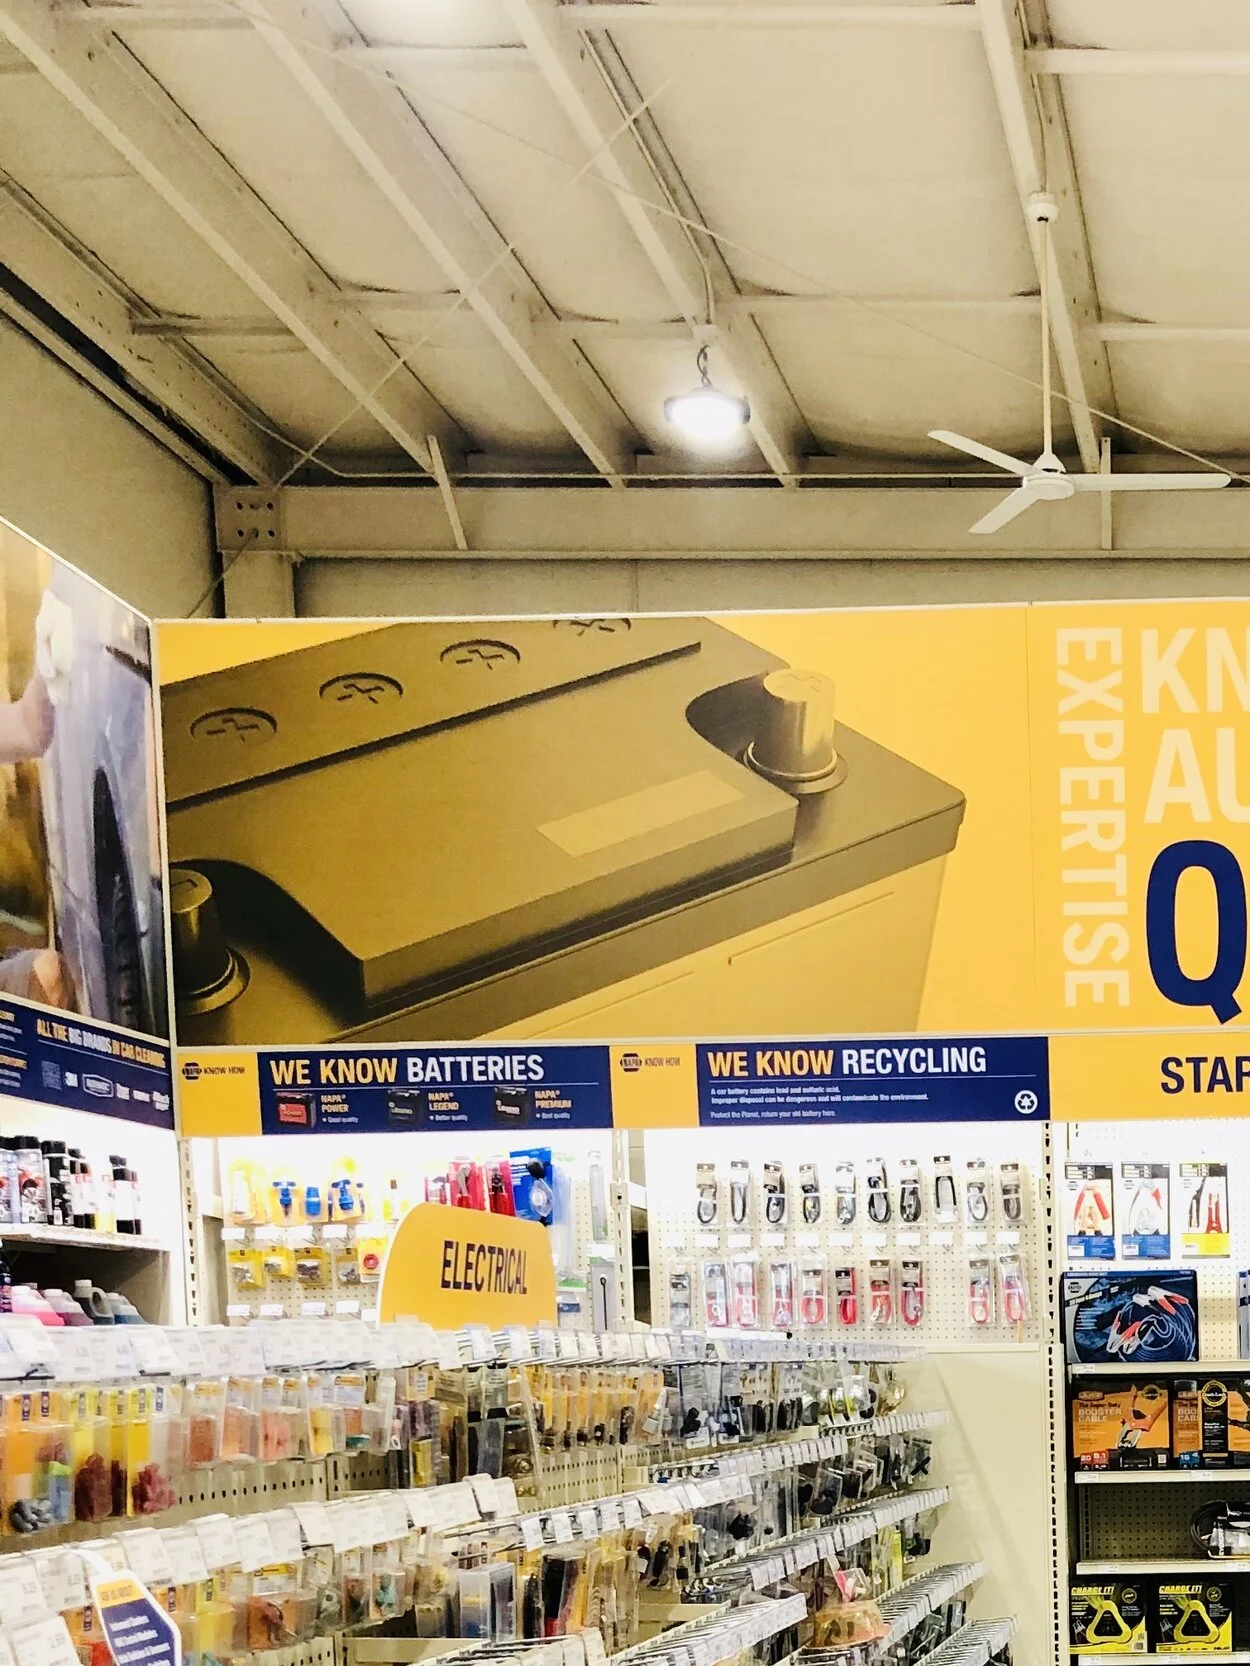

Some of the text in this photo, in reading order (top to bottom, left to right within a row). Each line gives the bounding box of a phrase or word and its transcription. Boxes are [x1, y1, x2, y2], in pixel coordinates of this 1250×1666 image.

[1055, 627, 1131, 1008] EXPERTISE
[644, 1057, 664, 1067] KNOW
[666, 1057, 680, 1066] HOW
[707, 1046, 986, 1077] WE KNOW RECYCLING
[270, 1054, 545, 1085] WE KNOW BATTERIES
[321, 1104, 349, 1113] POWER
[429, 1101, 459, 1111] LEGEND
[535, 1099, 571, 1109] PREMIUM
[441, 1240, 527, 1294] ELECTRICAL
[1078, 1407, 1122, 1416] BOOSTER
